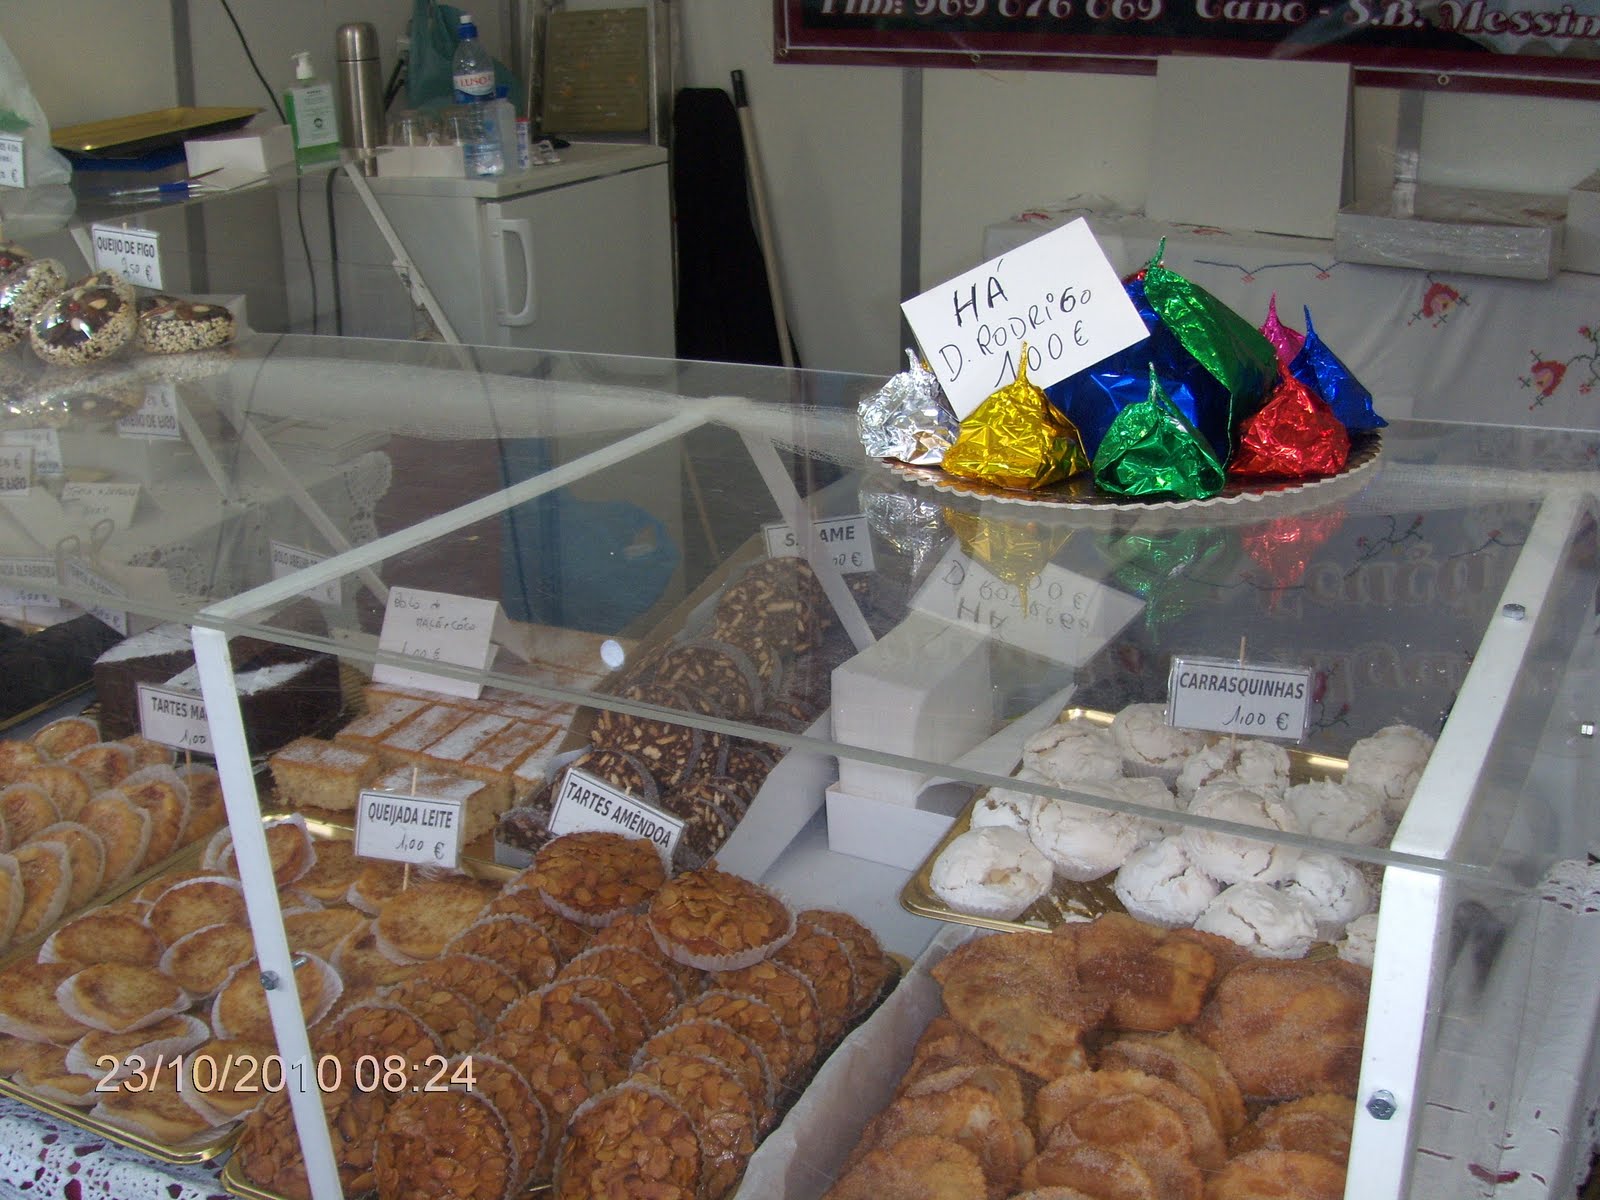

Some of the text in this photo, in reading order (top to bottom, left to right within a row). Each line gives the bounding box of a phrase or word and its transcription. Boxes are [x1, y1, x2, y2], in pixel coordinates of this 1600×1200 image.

[460, 76, 489, 87] LUSO
[97, 236, 155, 258] QUEIJO DE FIGO
[953, 258, 1008, 327] HÁ
[1074, 320, 1089, 347] €
[938, 344, 972, 383] D.
[785, 525, 855, 547] SAME
[1179, 672, 1305, 700] CARRASQUINHAS
[151, 697, 208, 721] TARTES MA
[1276, 711, 1290, 731] €
[368, 802, 453, 829] QUEIJADA LEITE
[566, 782, 672, 848] TARTES AMÊNDOA
[434, 841, 445, 860] €
